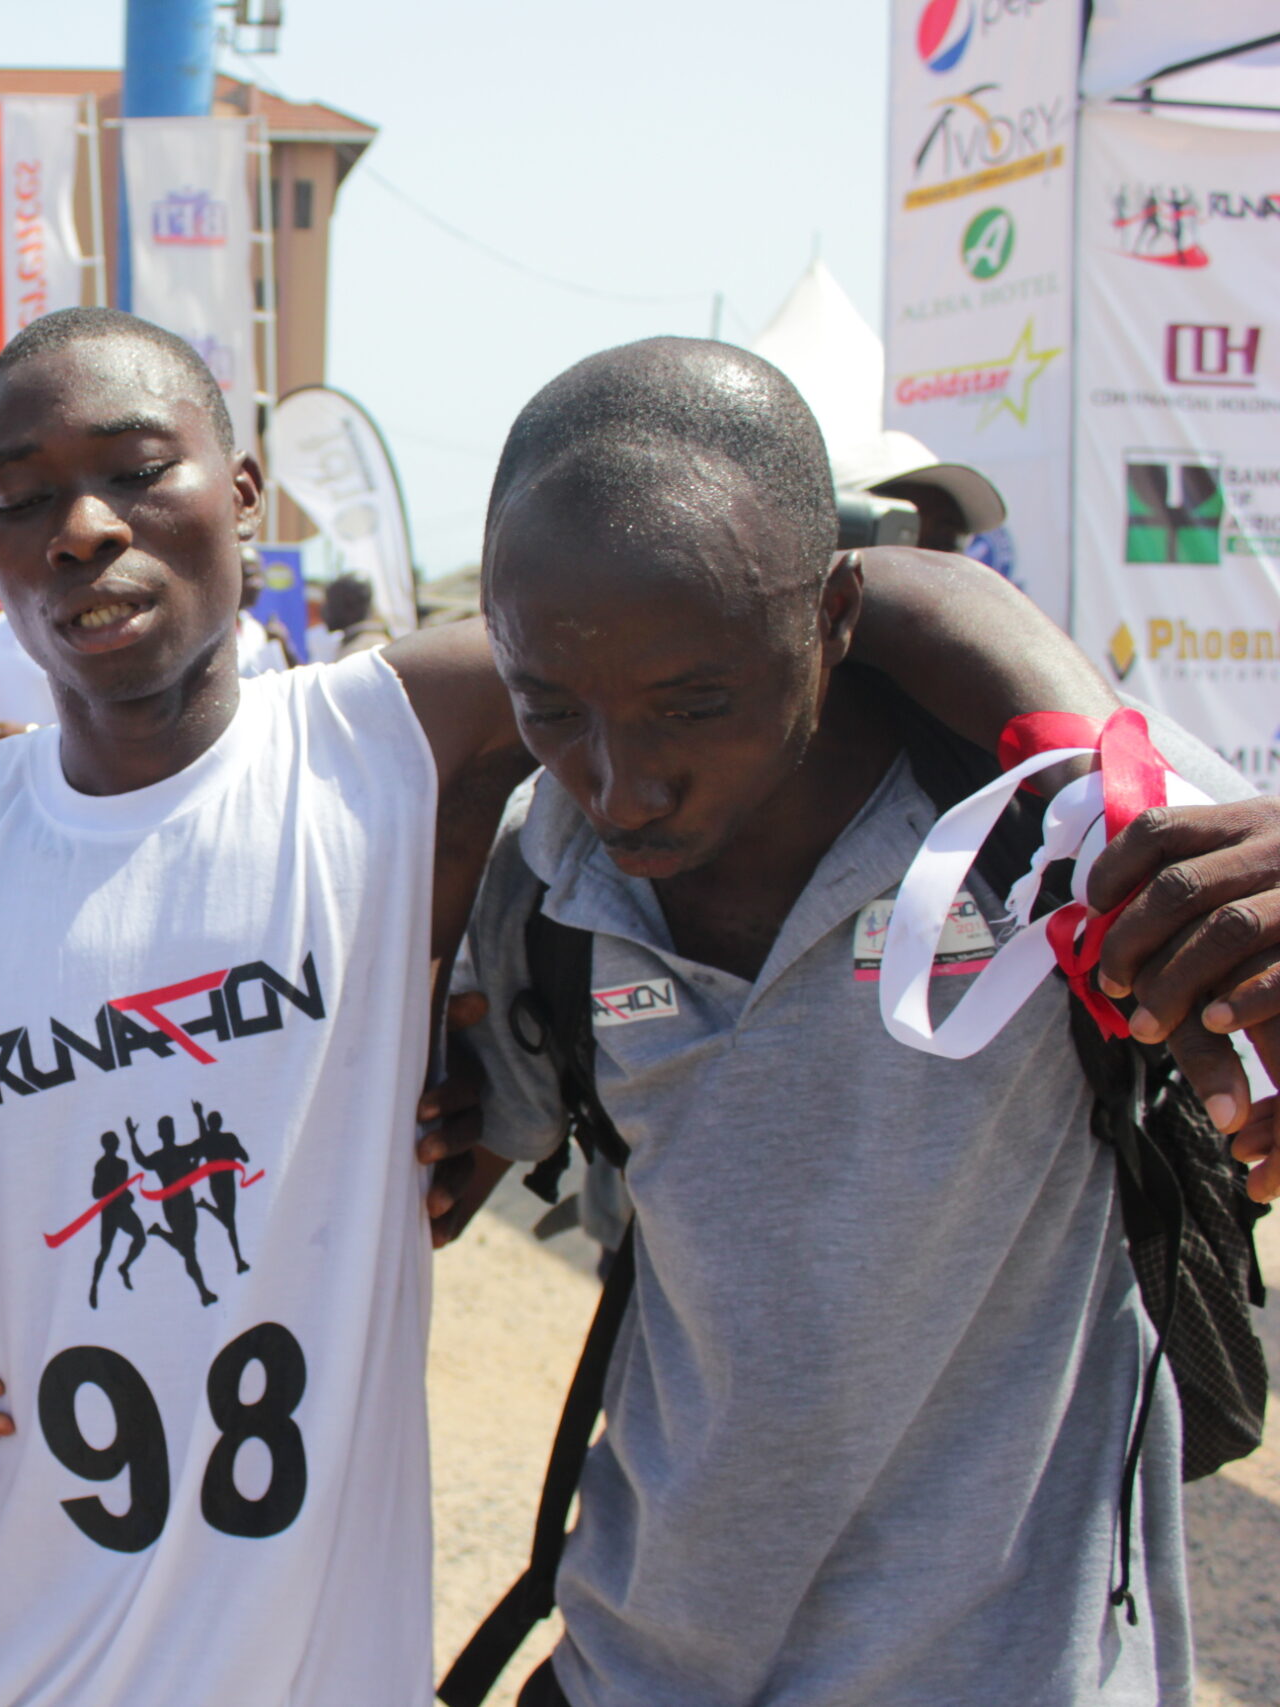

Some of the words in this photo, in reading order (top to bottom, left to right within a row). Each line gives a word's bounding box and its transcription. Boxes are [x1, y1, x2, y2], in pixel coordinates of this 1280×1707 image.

[1208, 191, 1280, 220] RUNA
[894, 367, 1011, 406] Goldstar
[1148, 617, 1280, 661] Phoen
[38, 1321, 308, 1554] 98
